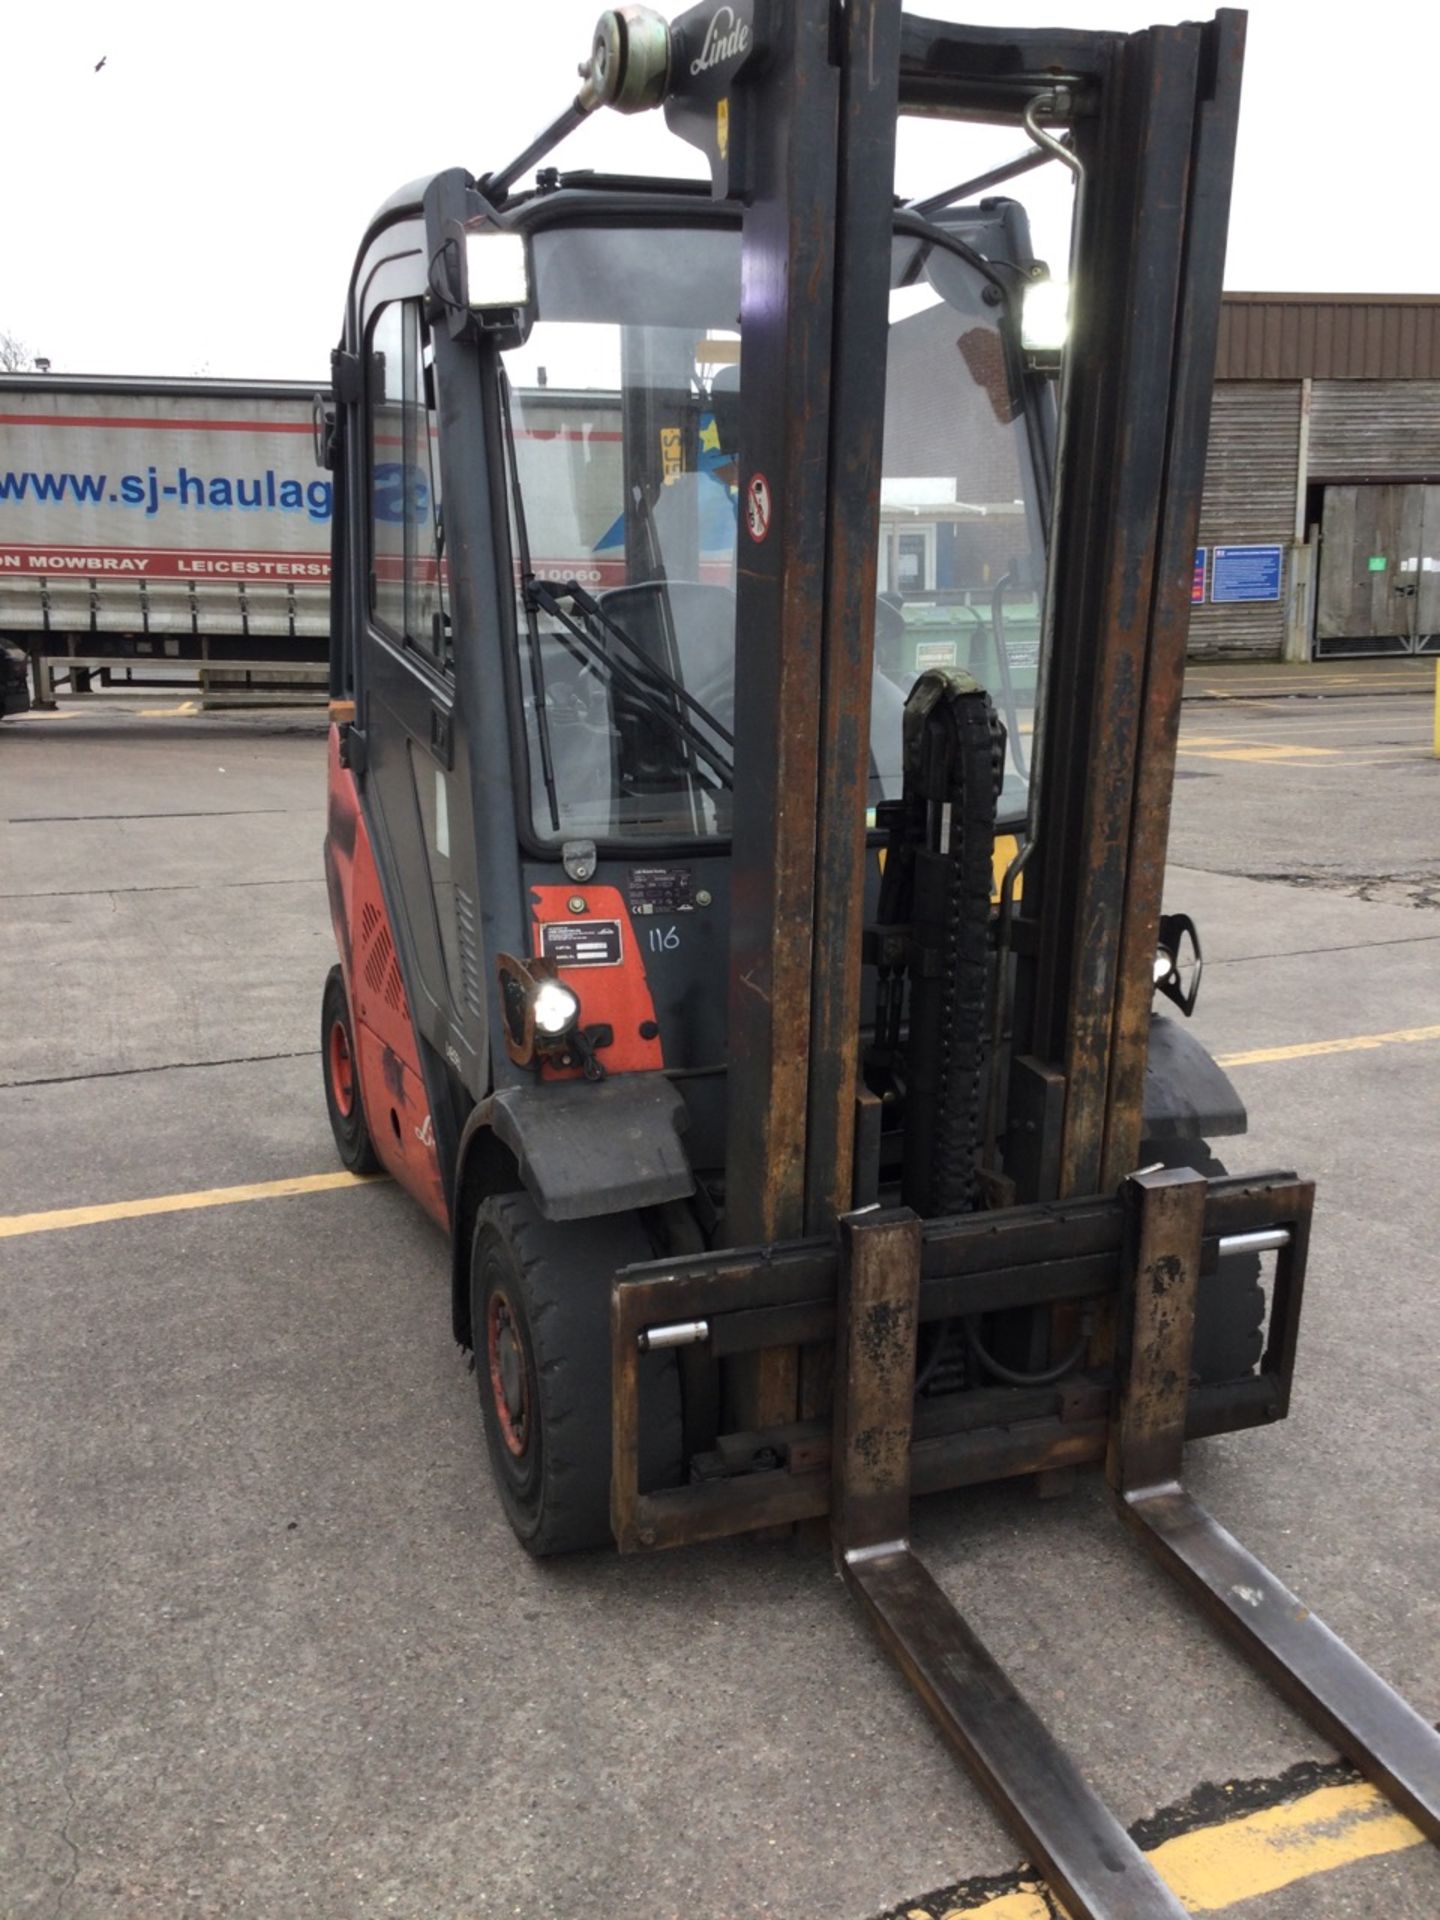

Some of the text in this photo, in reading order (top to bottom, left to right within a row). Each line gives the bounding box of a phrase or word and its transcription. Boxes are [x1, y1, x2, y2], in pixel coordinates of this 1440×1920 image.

[690, 6, 749, 76] Linde
[0, 555, 20, 567] N
[28, 555, 149, 570] MOWBRAY
[649, 925, 680, 952] 116
